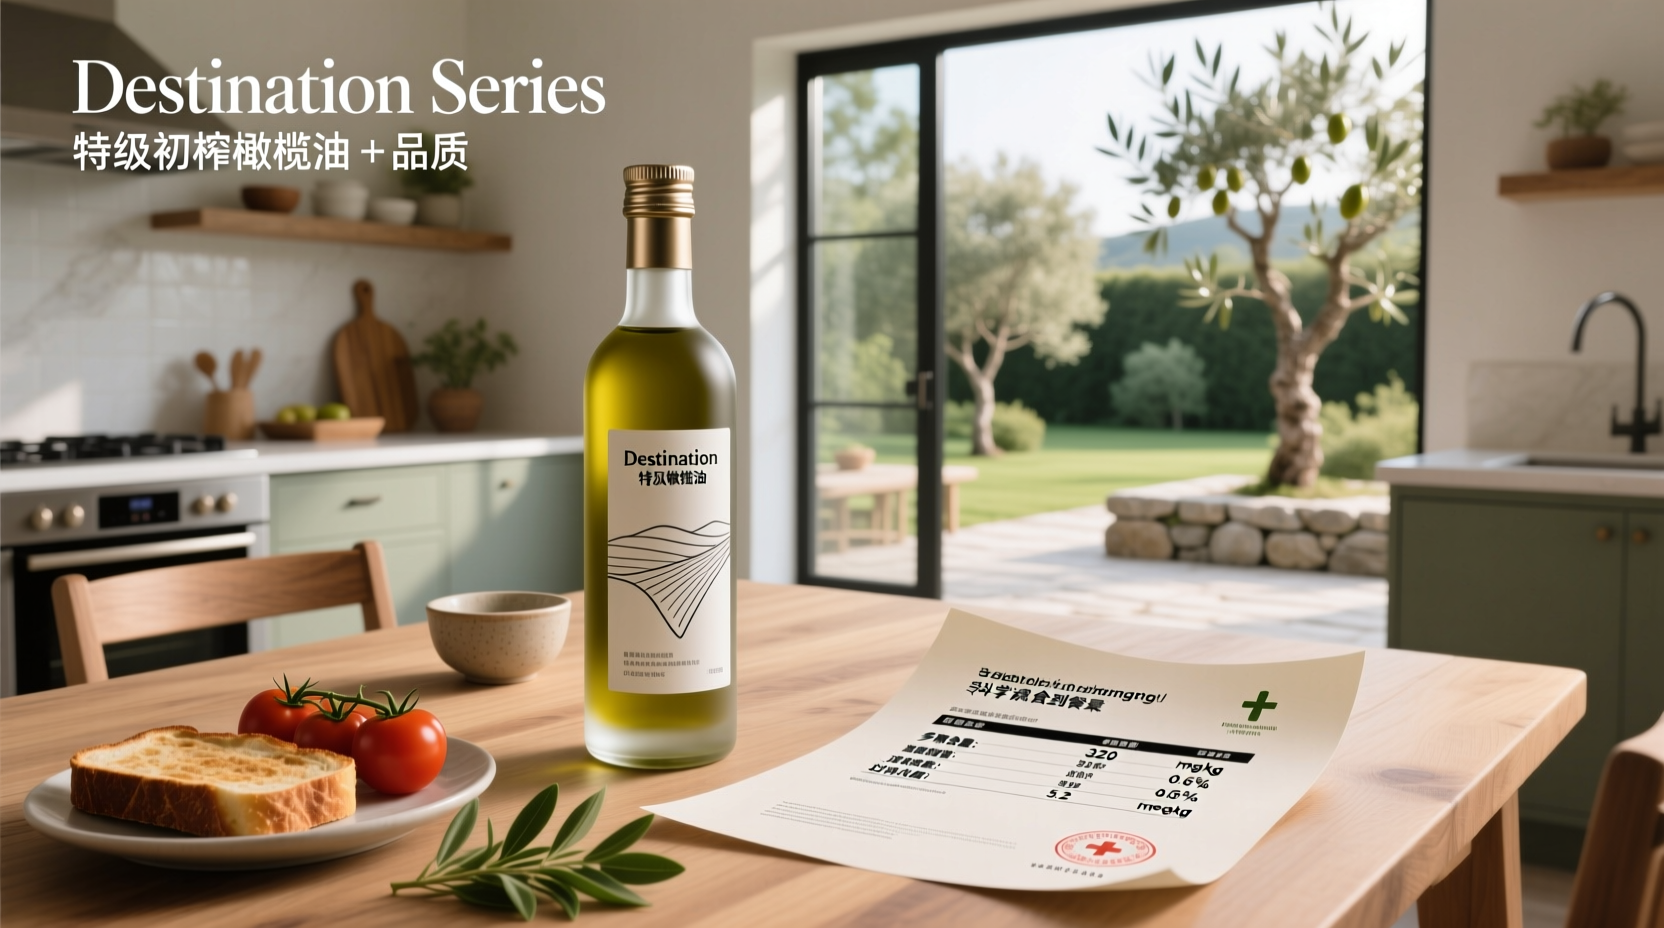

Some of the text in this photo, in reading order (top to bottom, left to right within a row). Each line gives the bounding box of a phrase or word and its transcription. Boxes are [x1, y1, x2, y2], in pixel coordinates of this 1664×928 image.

[624, 449, 718, 466] Destination
[1085, 748, 1118, 760] 320
[1046, 789, 1072, 800] 5.2
